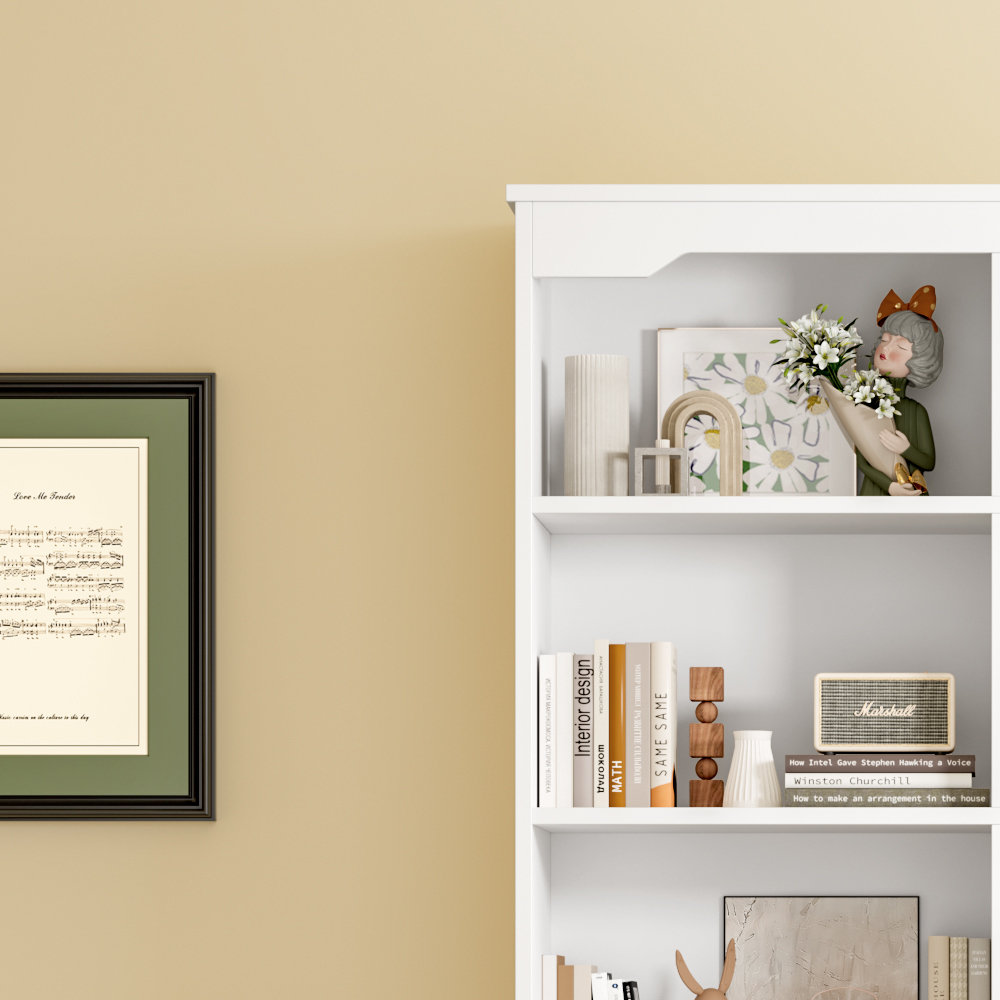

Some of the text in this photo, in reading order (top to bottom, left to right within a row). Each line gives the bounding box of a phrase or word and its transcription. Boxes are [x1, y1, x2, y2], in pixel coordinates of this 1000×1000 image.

[574, 659, 594, 757] Interior design
[854, 701, 917, 717] Marshall
[655, 692, 667, 776] SAME SAME
[597, 744, 605, 793] ШОКОЛАД
[861, 759, 895, 768] Stephen
[899, 759, 933, 768] Hawking
[611, 760, 623, 792] MATH
[794, 776, 911, 785] Winston Churchill
[793, 794, 809, 802] How
[828, 794, 848, 802] make
[867, 795, 921, 804] arrangement
[926, 794, 937, 802] in
[941, 794, 956, 802] the
[960, 794, 986, 802] house
